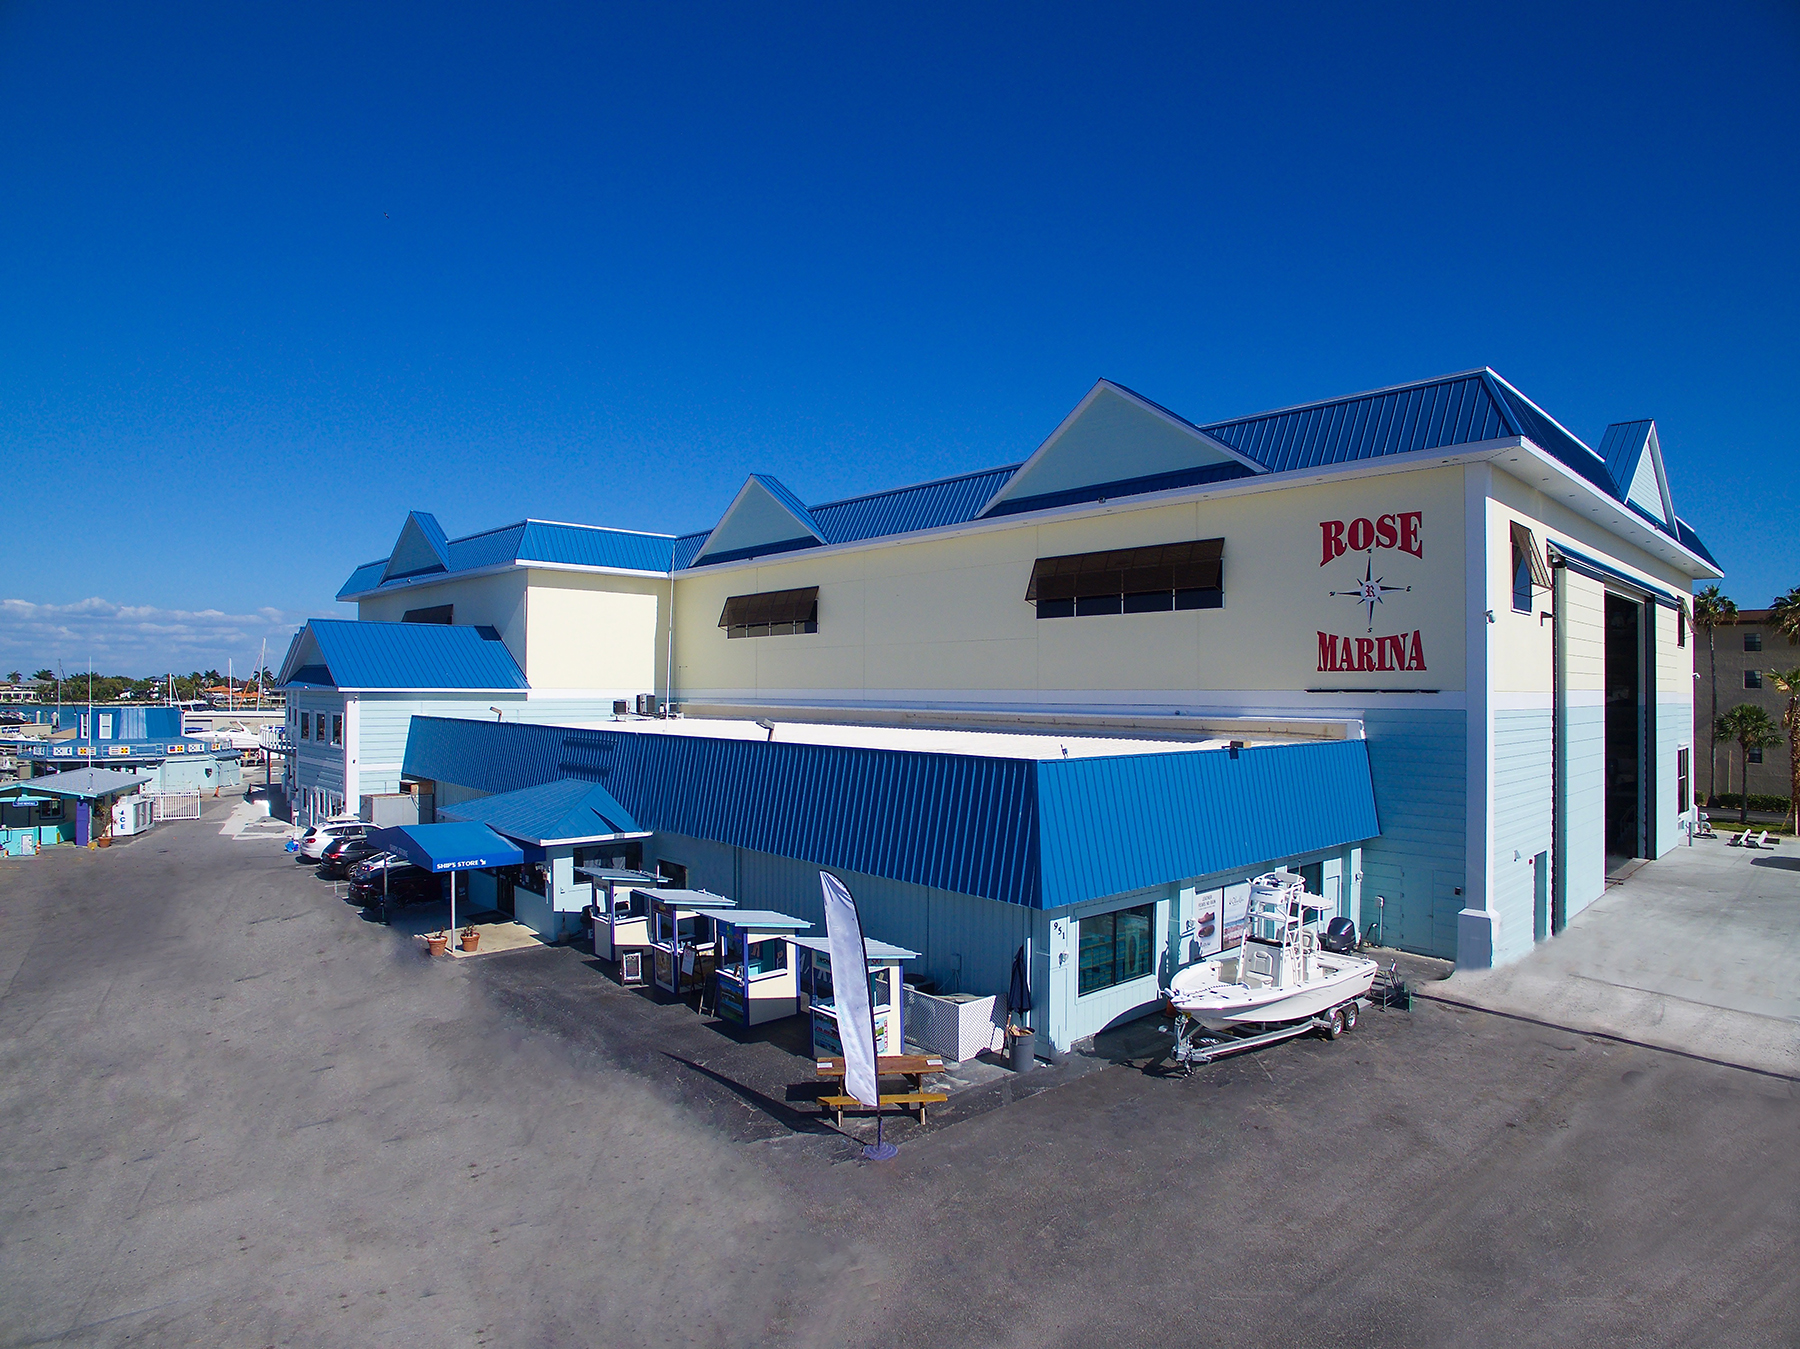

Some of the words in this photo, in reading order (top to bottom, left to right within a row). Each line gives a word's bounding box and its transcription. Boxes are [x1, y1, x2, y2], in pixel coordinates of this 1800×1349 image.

[1319, 511, 1423, 567] ROSE
[1317, 629, 1427, 672] MARINA
[1053, 922, 1065, 940] 951
